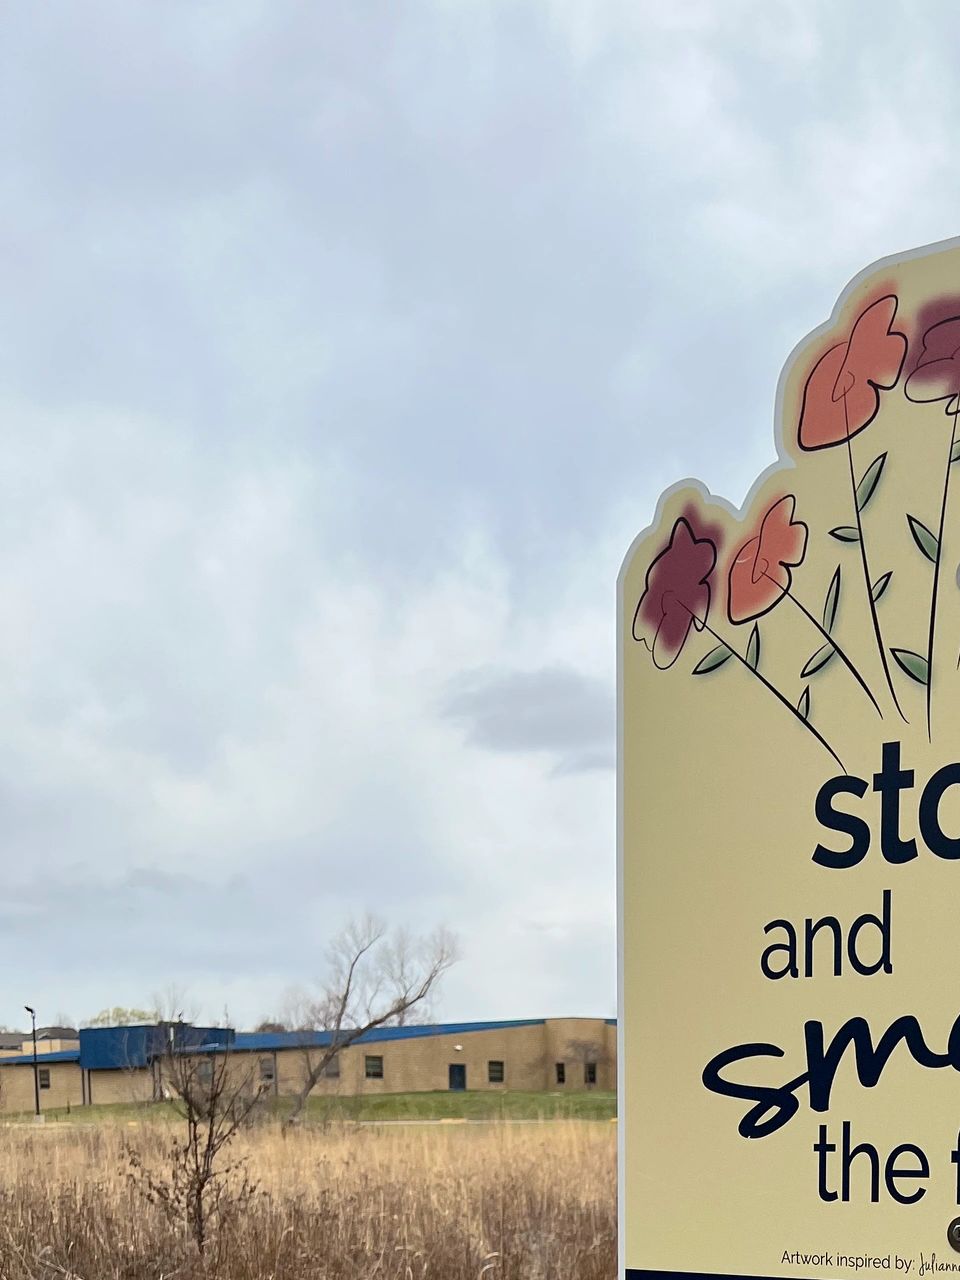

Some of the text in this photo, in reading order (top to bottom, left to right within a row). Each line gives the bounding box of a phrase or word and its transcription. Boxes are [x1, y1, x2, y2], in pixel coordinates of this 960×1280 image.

[760, 889, 893, 980] and
[813, 1120, 931, 1205] the
[781, 1250, 833, 1267] Artwork
[836, 1252, 891, 1271] inspired
[894, 1255, 916, 1274] by:
